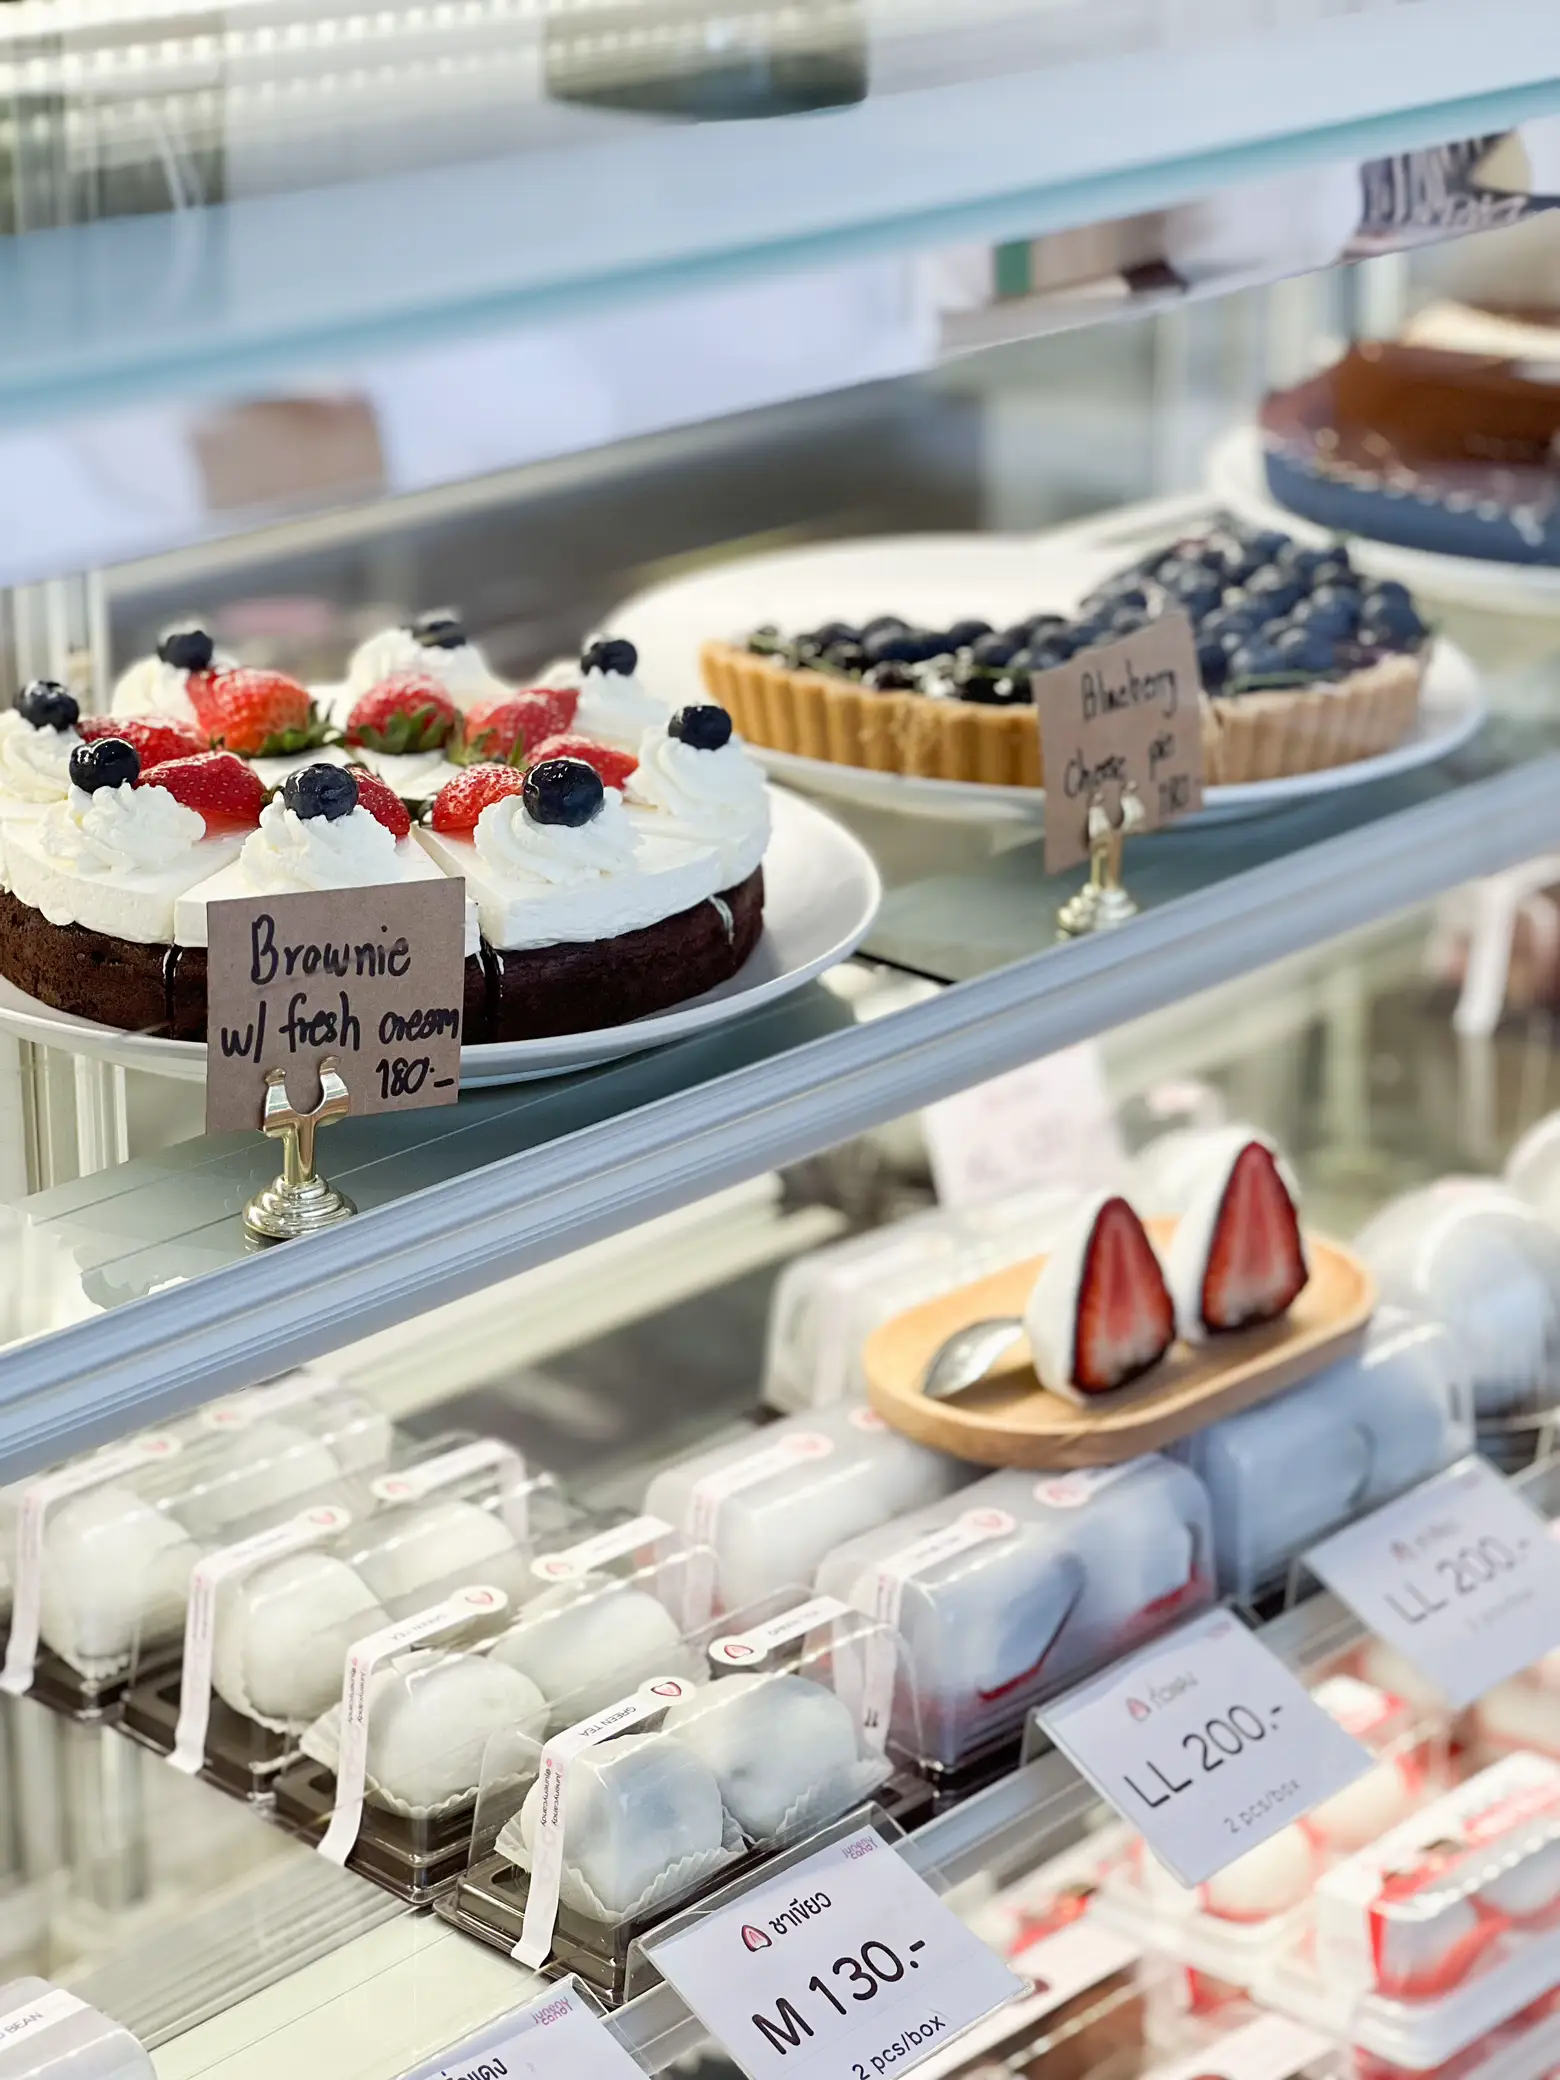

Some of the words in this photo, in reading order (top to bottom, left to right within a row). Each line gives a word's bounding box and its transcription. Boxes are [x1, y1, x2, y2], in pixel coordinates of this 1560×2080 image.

[251, 914, 411, 985] Brownie
[221, 1000, 267, 1063] w/
[279, 991, 361, 1053] fresh
[379, 1008, 459, 1044] cream
[1384, 1581, 1450, 1625] LL
[579, 1723, 602, 1738] TEA
[601, 1706, 637, 1727] GREEN
[1123, 1760, 1193, 1808] LL
[1182, 1704, 1284, 1772] 200.-
[540, 1768, 553, 1828] @junenycandy
[551, 1772, 562, 1827] junenycandy
[1223, 1817, 1239, 1835] 2
[1238, 1778, 1301, 1828] pcs/box
[768, 1890, 832, 1936] ชาเขียว
[4, 2011, 44, 2034] BEAN
[751, 1997, 815, 2056] M
[808, 1939, 926, 2016] 130.-
[851, 2062, 870, 2080] 2
[870, 2014, 946, 2074] pcs/box
